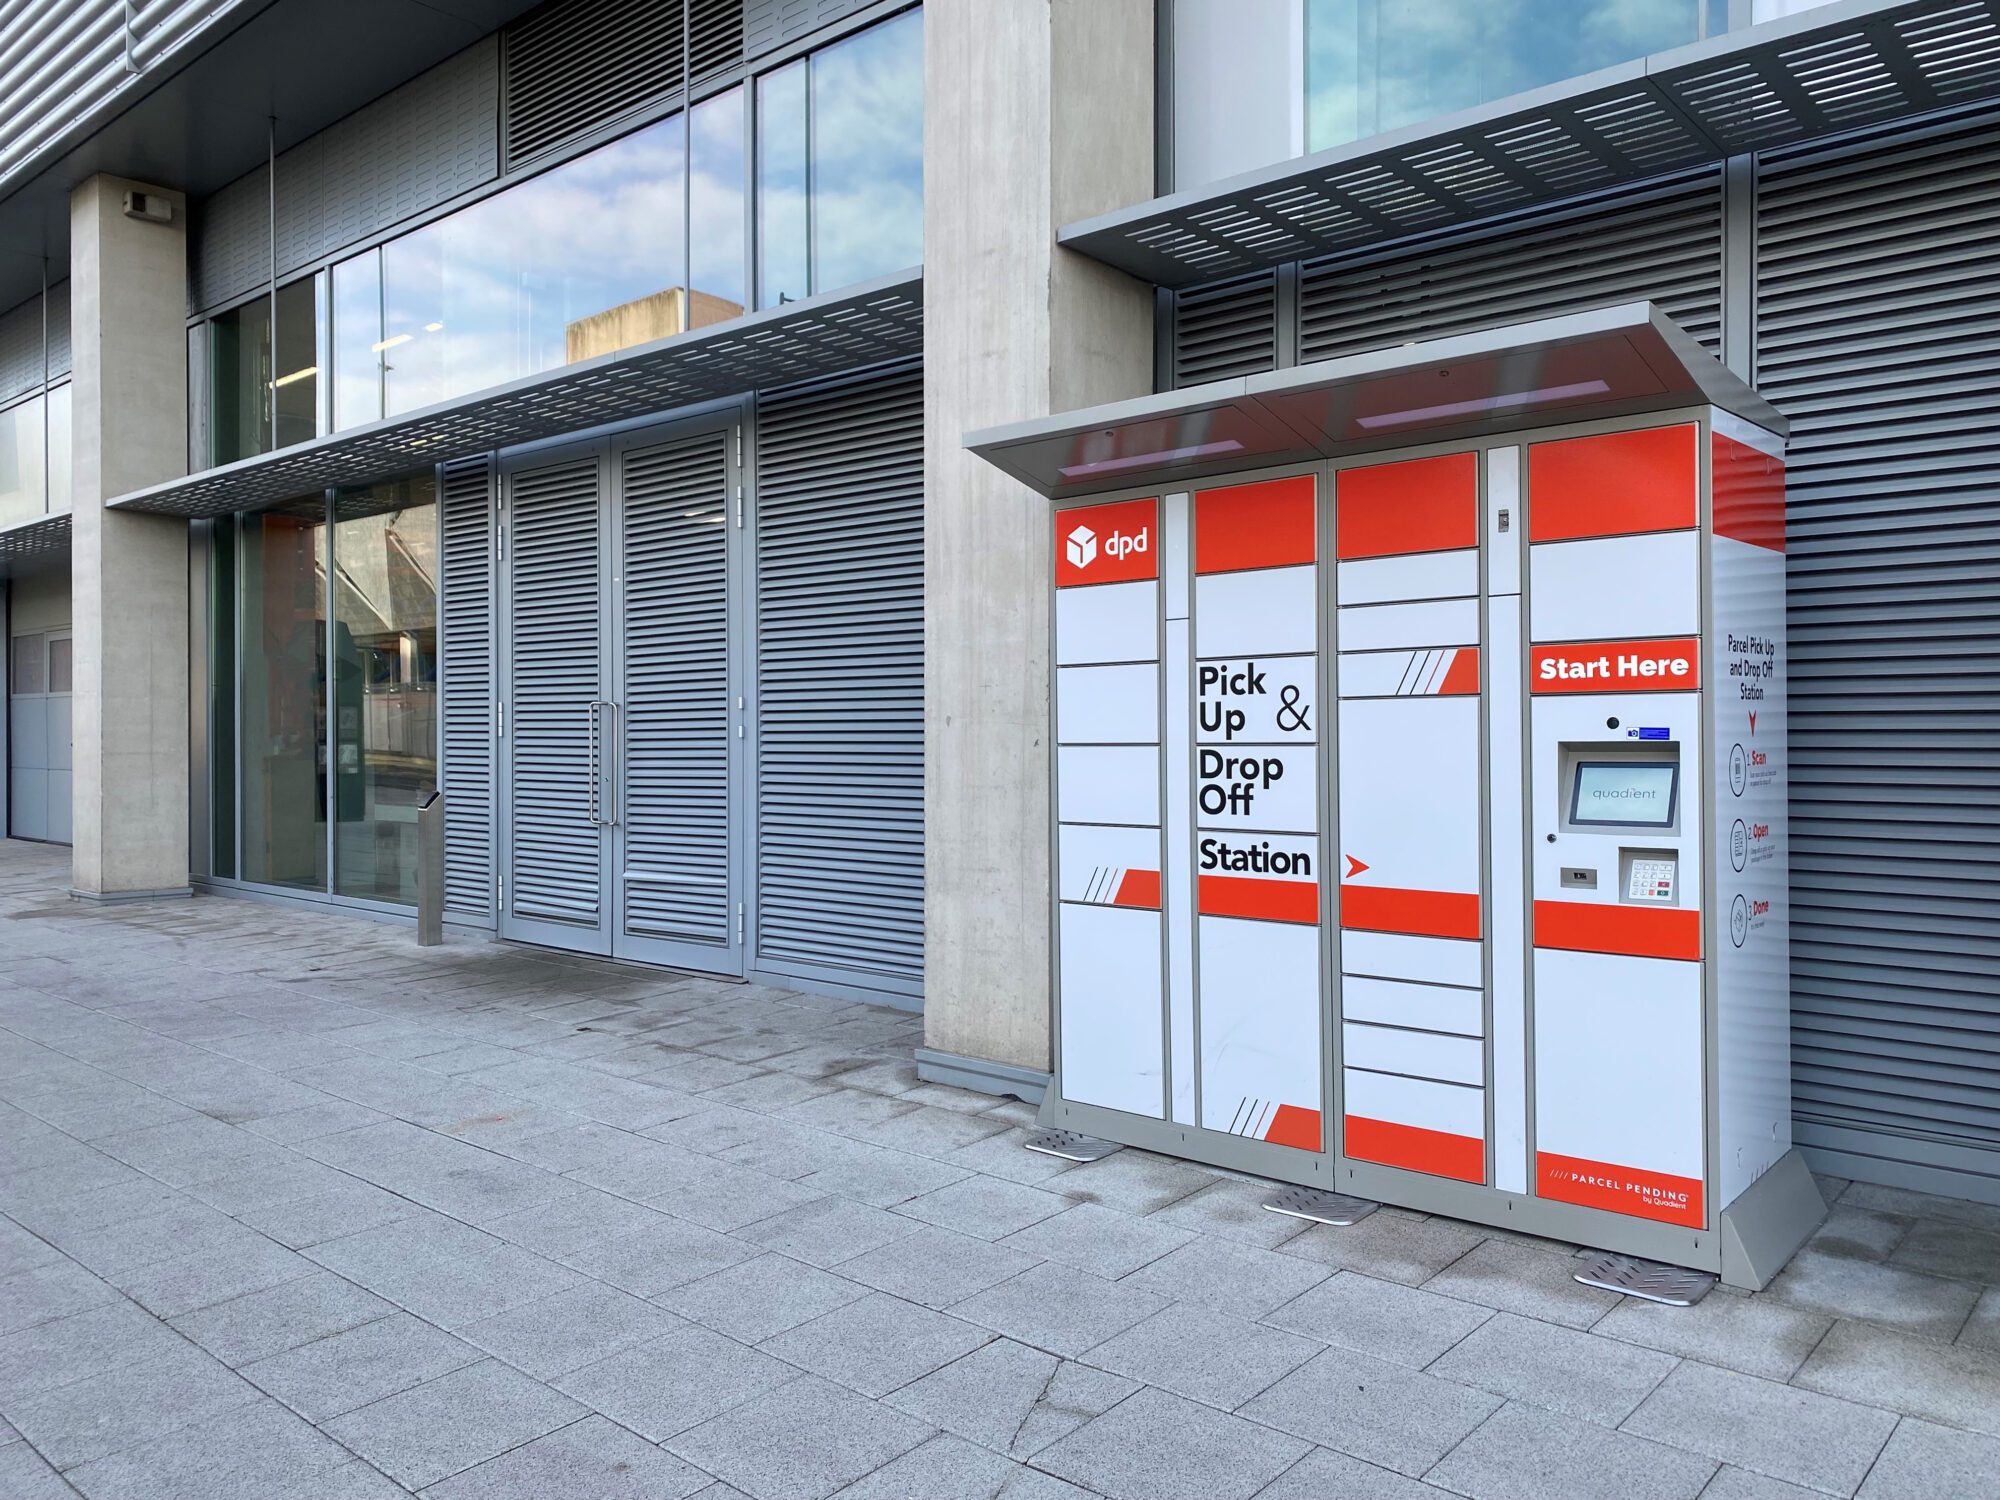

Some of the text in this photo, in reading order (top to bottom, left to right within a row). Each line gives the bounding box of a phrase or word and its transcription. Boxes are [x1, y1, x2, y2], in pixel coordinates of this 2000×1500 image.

[1105, 527, 1147, 560] dpd
[1728, 634, 1774, 660] Parcel Pick Up
[1200, 662, 1266, 696] Pick
[1540, 655, 1689, 680] Start Here
[1730, 658, 1773, 682] and Drop Off
[1741, 683, 1763, 700] Station
[1200, 685, 1311, 740] Up &
[1200, 749, 1283, 789] Drop
[1752, 750, 1766, 766] Scan
[1199, 783, 1254, 815] Off
[1593, 788, 1656, 800] quadient
[1753, 823, 1768, 842] Open
[1200, 839, 1310, 875] Station
[1754, 900, 1768, 916] Done
[1572, 1173, 1687, 1203] PARCEL PENDING
[1643, 1195, 1687, 1210] by Quadient
